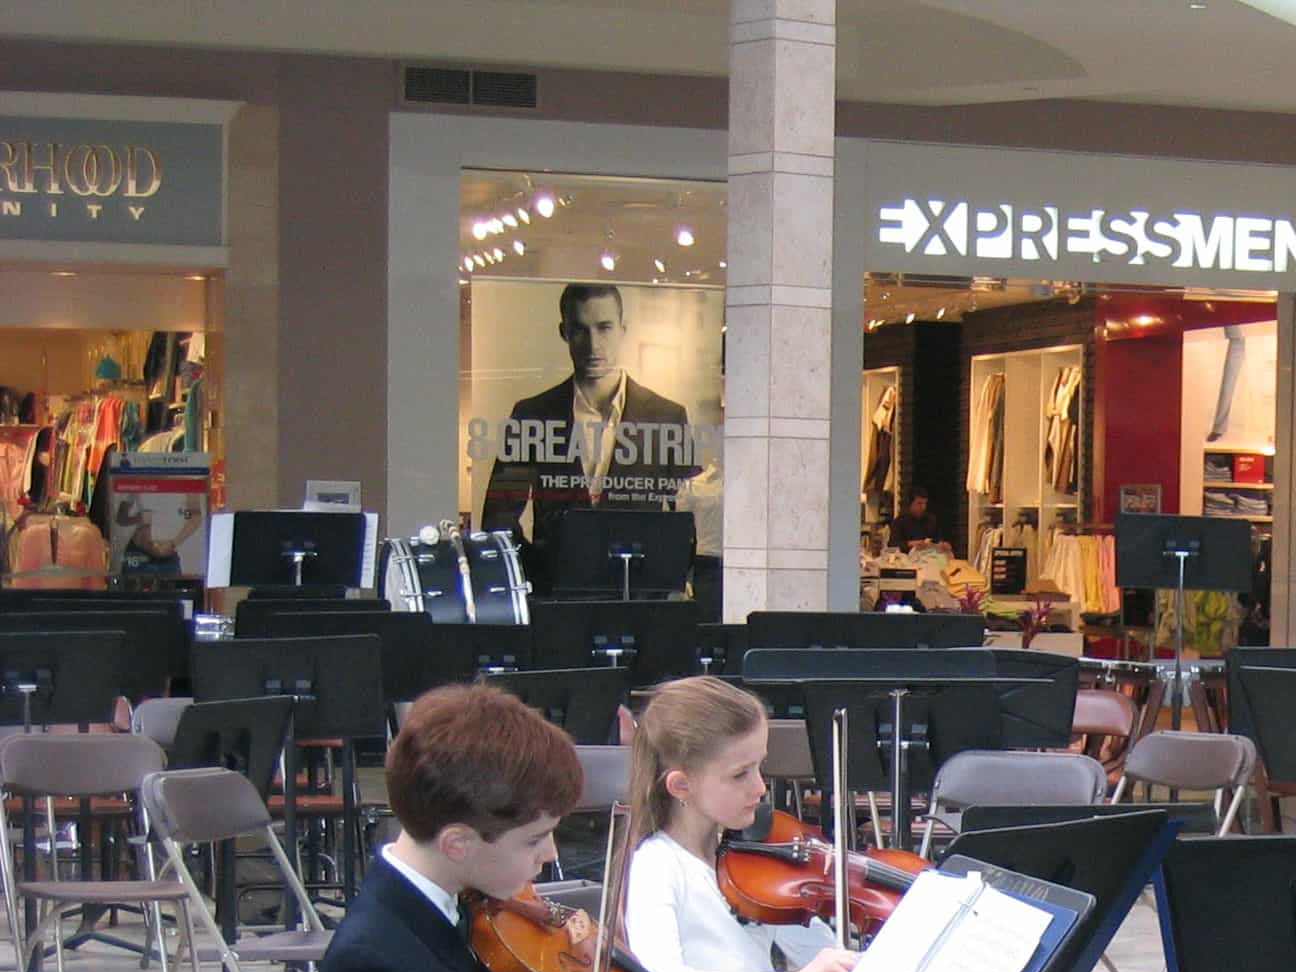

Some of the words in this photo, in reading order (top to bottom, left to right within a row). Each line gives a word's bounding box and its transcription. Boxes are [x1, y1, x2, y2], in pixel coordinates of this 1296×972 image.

[2, 201, 145, 221] NITY
[467, 417, 490, 461] 8
[499, 418, 606, 464] GREAT
[540, 475, 569, 489] THE
[570, 477, 655, 490] PRODUCER
